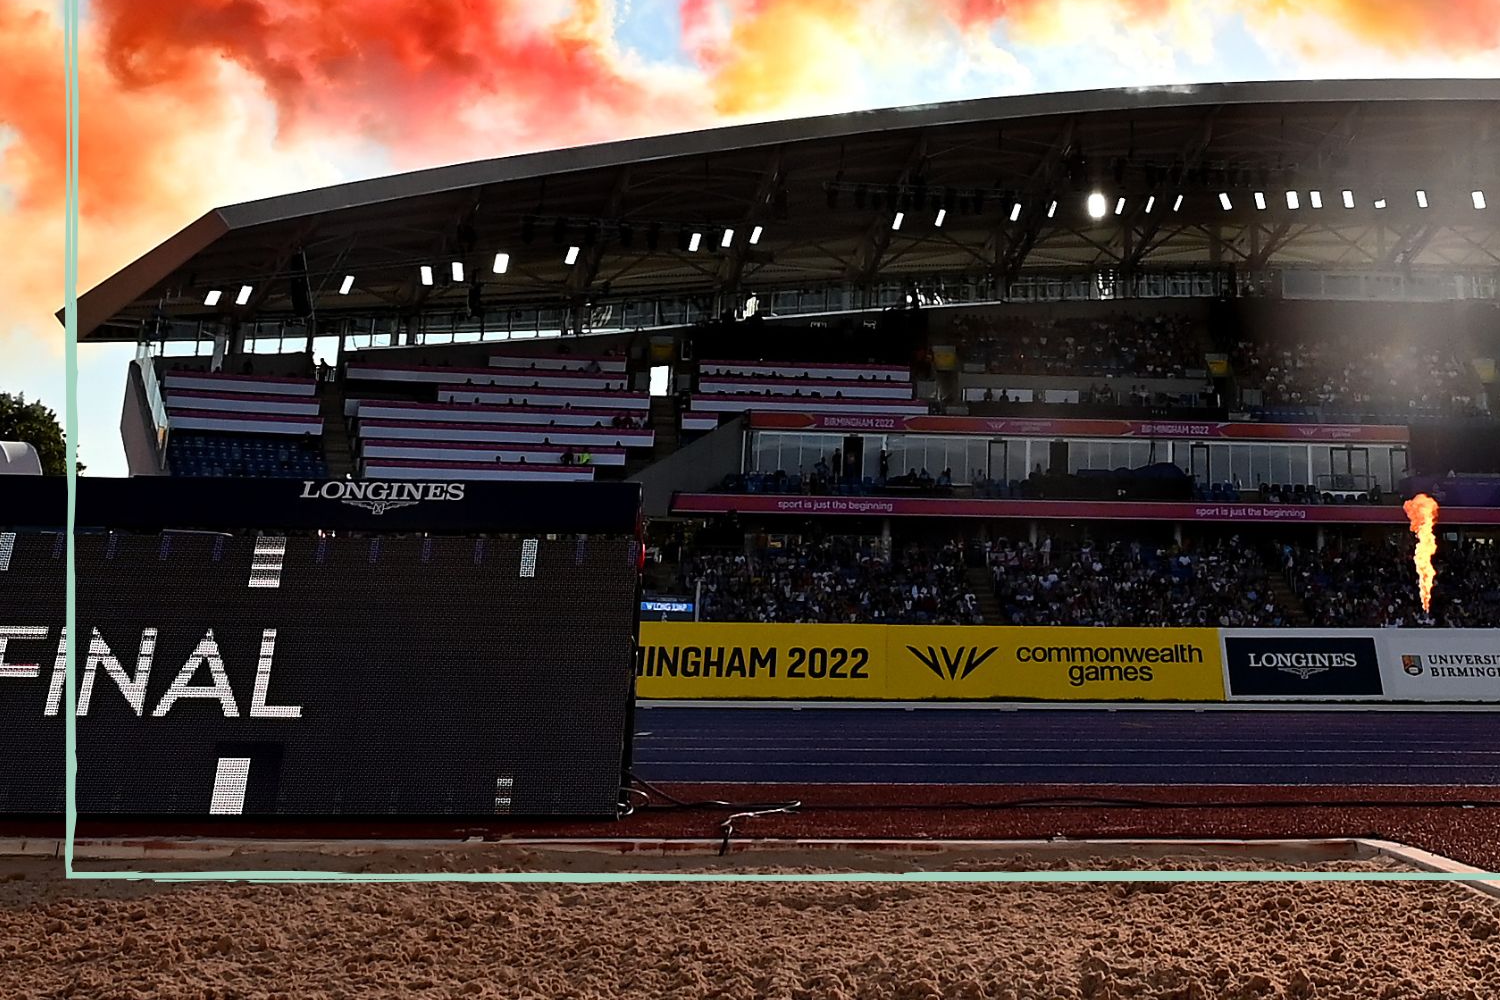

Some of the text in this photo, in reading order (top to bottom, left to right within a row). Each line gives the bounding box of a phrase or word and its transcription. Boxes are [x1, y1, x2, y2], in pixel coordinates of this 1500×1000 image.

[875, 419, 894, 428] 2022
[1189, 426, 1209, 435] 2022
[299, 481, 466, 501] LONGINES
[778, 500, 803, 510] sport
[813, 500, 830, 510] just
[848, 501, 893, 512] beginning
[1195, 507, 1219, 516] sport
[1229, 507, 1246, 517] just
[1263, 508, 1306, 518] beginning
[1016, 644, 1203, 663] commonwealth
[1247, 653, 1358, 667] LONGINES
[787, 647, 869, 679] 2022
[0, 626, 303, 718] FINAL
[1068, 665, 1153, 686] games
